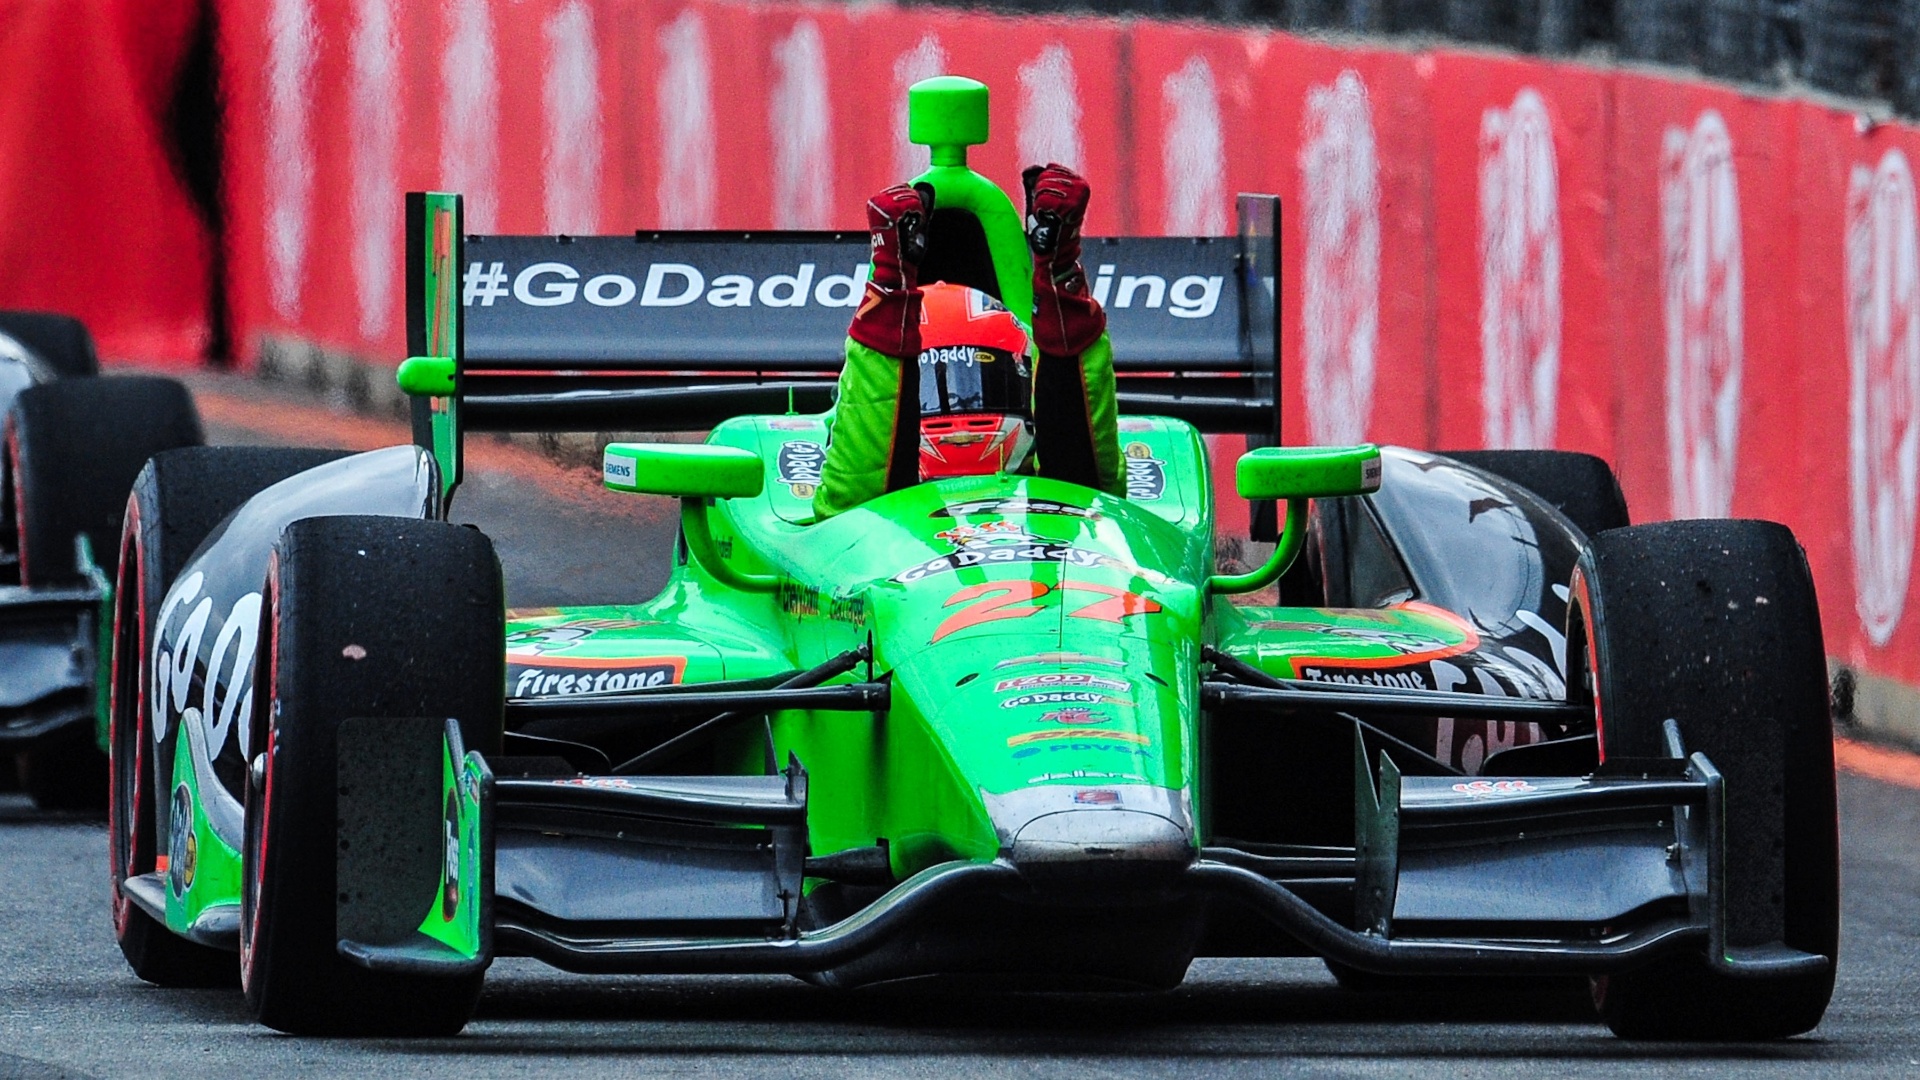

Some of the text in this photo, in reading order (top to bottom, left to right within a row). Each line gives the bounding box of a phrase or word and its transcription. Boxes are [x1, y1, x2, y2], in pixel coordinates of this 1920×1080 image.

[918, 346, 975, 367] oDaddy
[929, 580, 1162, 646] 27
[515, 668, 666, 698] Firestone
[1003, 675, 1085, 689] IZOD
